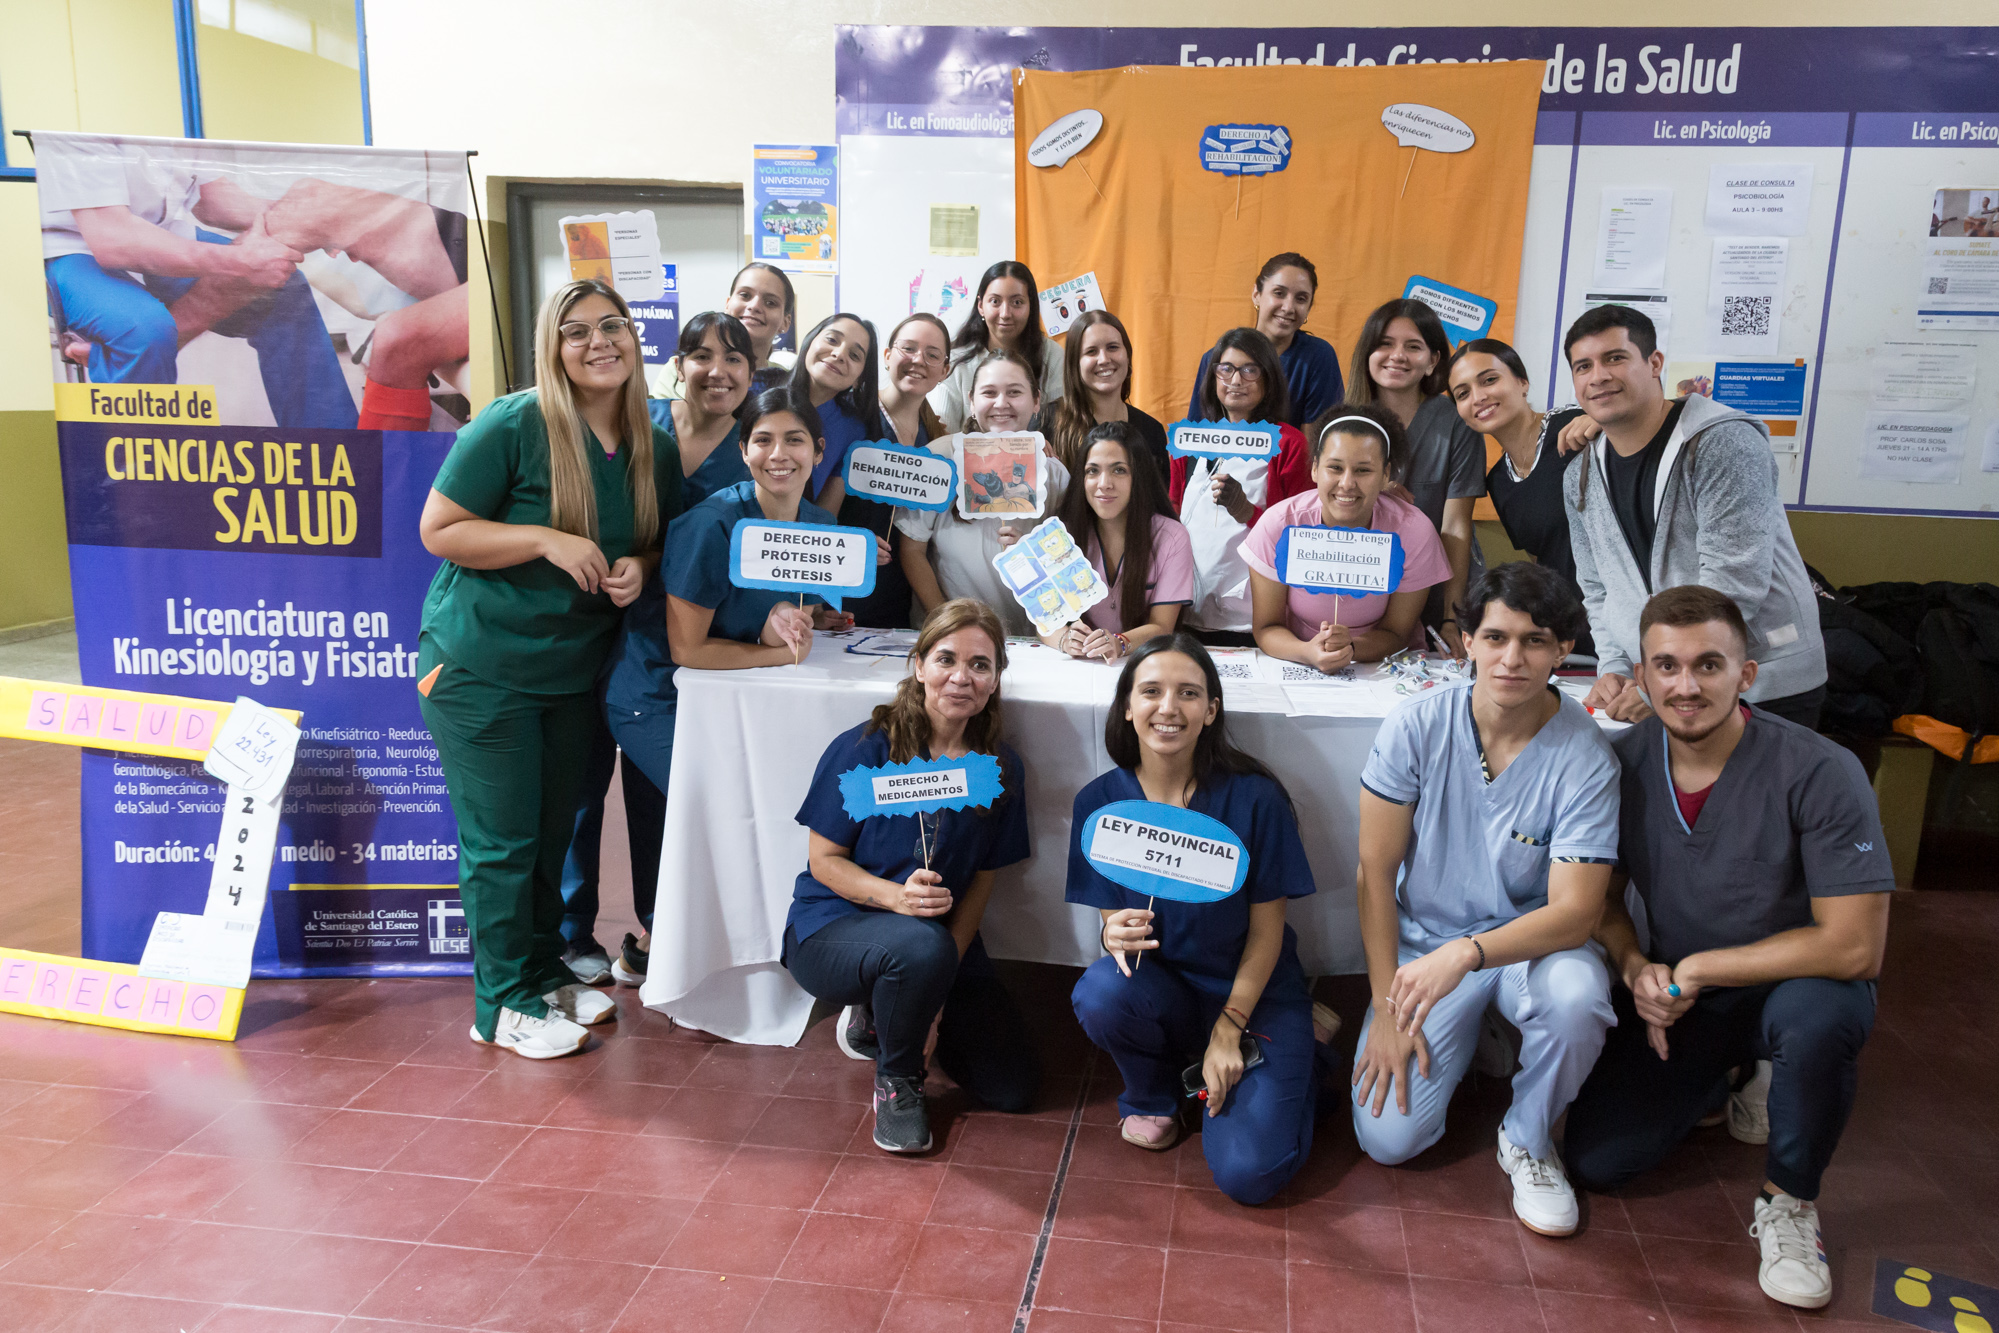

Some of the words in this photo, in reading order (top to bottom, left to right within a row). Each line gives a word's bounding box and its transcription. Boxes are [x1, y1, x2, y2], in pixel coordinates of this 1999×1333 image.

[1541, 43, 1585, 94] de
[1594, 43, 1627, 94] la
[1635, 43, 1742, 94] Salud
[887, 112, 907, 130] Lic.
[910, 116, 924, 130] en
[1383, 119, 1433, 139] enriquecen
[1389, 105, 1404, 117] Las
[1405, 111, 1454, 133] diferencias
[1456, 128, 1473, 138] nos
[1071, 132, 1083, 145] BIEN
[1220, 130, 1261, 139] DERECHO
[1654, 120, 1677, 139] Lic.
[1680, 125, 1697, 139] en
[1700, 120, 1771, 144] Psicología
[1912, 121, 1936, 140] Lic.
[1940, 126, 1958, 140] en
[1031, 143, 1047, 157] TODOS
[1047, 135, 1063, 149] SOMOS
[1206, 153, 1281, 163] REHABILITACION!
[759, 166, 833, 176] VOLUNTARIADO
[761, 176, 830, 186] UNIVERSITARIO
[1760, 179, 1795, 187] CONSULTA
[1039, 275, 1092, 301] CEGUERA
[1412, 294, 1429, 304] PERO
[1443, 305, 1456, 313] LOS
[1457, 309, 1481, 322] MISMOS
[1420, 288, 1441, 300] SOMOS
[1442, 296, 1479, 313] DIFERENTES
[643, 305, 675, 320] MÁXIMA
[634, 322, 646, 343] 2
[91, 388, 180, 418] Facultad
[187, 391, 212, 419] de
[1179, 432, 1231, 445] ¡TENGO
[1235, 436, 1269, 448] CUD!
[105, 436, 255, 484] CIENCIAS
[263, 442, 302, 485] DE
[312, 443, 356, 487] LA
[883, 452, 923, 467] TENGO
[852, 461, 949, 487] REHABILITACIÓN
[869, 480, 927, 498] GRATUITA
[213, 487, 358, 545] SALUD
[763, 532, 831, 547] DERECHO
[836, 538, 846, 548] A
[1291, 528, 1324, 541] Tengo
[1326, 530, 1358, 544] CUD,
[1361, 534, 1391, 546] tengo
[761, 549, 831, 565] PRÓTESIS
[836, 555, 846, 565] Y
[1296, 548, 1381, 566] Rehabilitación
[771, 566, 833, 582] ÓRTESIS
[1304, 570, 1385, 589] GRATUITA!
[166, 597, 345, 638] Licenciatura
[353, 610, 389, 638] en
[113, 637, 297, 685] Kinesiología
[302, 650, 320, 686] y
[40, 698, 204, 741] SALUD
[255, 721, 279, 747] Ley
[310, 727, 380, 741] Kinefisiátrico
[235, 737, 275, 767] 22.431
[114, 762, 189, 779] Gerontológica,
[352, 764, 408, 779] Ergonomía
[114, 782, 127, 795] de
[128, 782, 138, 795] la
[140, 782, 208, 795] Biomecánica
[316, 783, 354, 796] Laboral
[364, 782, 410, 796] Atención
[888, 775, 939, 787] DERECHO
[942, 774, 950, 782] A
[878, 785, 963, 801] MEDICAMENTOS
[115, 801, 126, 814] de
[128, 801, 137, 814] la
[138, 801, 169, 814] Salud
[177, 801, 221, 814] Servicio
[306, 800, 376, 817] Investigación
[384, 800, 443, 813] Prevención.
[1101, 817, 1133, 834] LEY
[1137, 826, 1234, 860] PROVINCIAL
[115, 840, 200, 863] Duración:
[204, 846, 216, 863] 4
[228, 796, 254, 906] 2024
[281, 842, 335, 862] medio
[353, 842, 376, 863] 34
[380, 839, 458, 862] materias
[1145, 849, 1182, 868] 5711
[1091, 852, 1108, 860] SISTEMA
[1142, 864, 1162, 874] INTEGRAL
[1170, 871, 1204, 884] DISCAPACITADO
[1213, 882, 1231, 890] FAMILIA
[313, 910, 375, 920] Universidad
[377, 909, 418, 919] Católica
[304, 922, 317, 931] de
[320, 922, 364, 933] Santiago
[367, 921, 383, 930] del
[386, 921, 418, 930] Estero
[429, 939, 470, 953] UCSE
